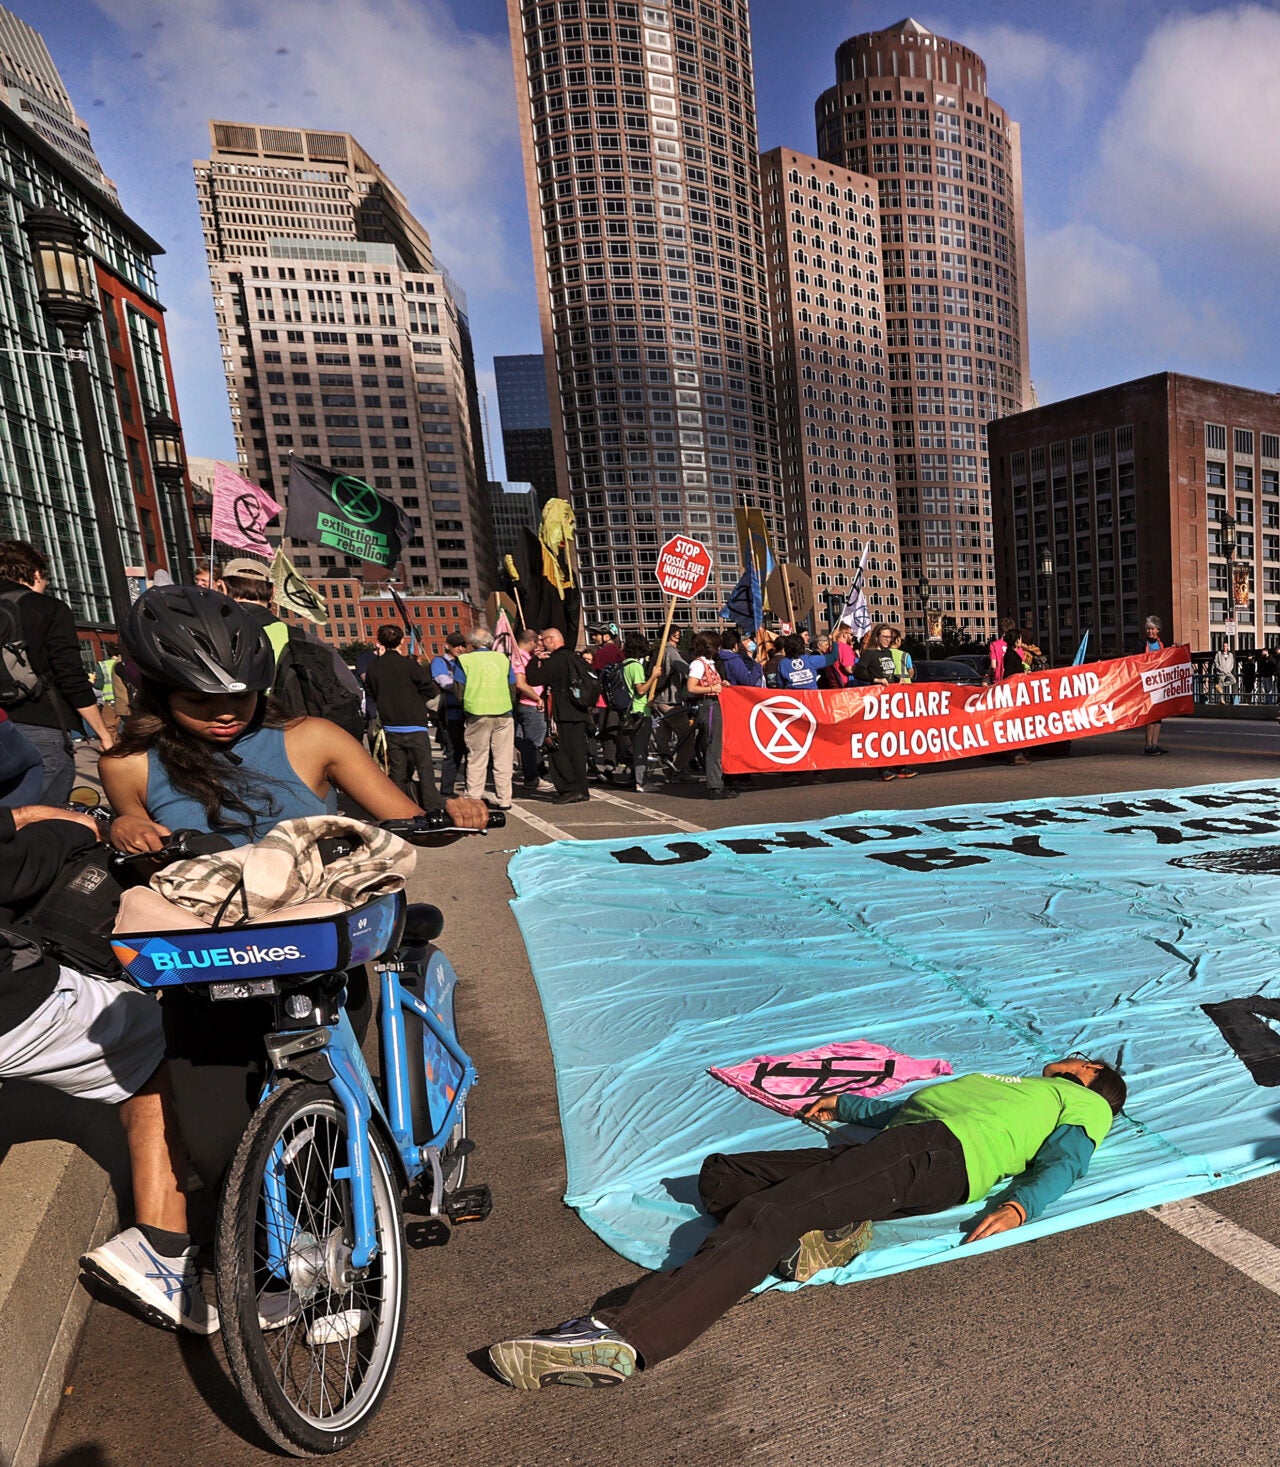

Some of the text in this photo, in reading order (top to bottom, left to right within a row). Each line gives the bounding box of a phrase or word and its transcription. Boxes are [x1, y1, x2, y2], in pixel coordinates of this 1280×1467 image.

[321, 515, 379, 545] extinction
[675, 540, 701, 557] STOP
[662, 553, 686, 569] FOSSIL
[687, 562, 705, 575] FUEL
[663, 564, 699, 582] INDUSTRY
[664, 575, 693, 594] NOW!
[1145, 666, 1191, 686] extinction
[862, 671, 1101, 721] DECLARE CLIMATE AND
[851, 702, 1116, 759] ECOLOGICAL EMERGENCY
[865, 833, 1068, 872] BY
[150, 945, 301, 971] BLUEbikes
